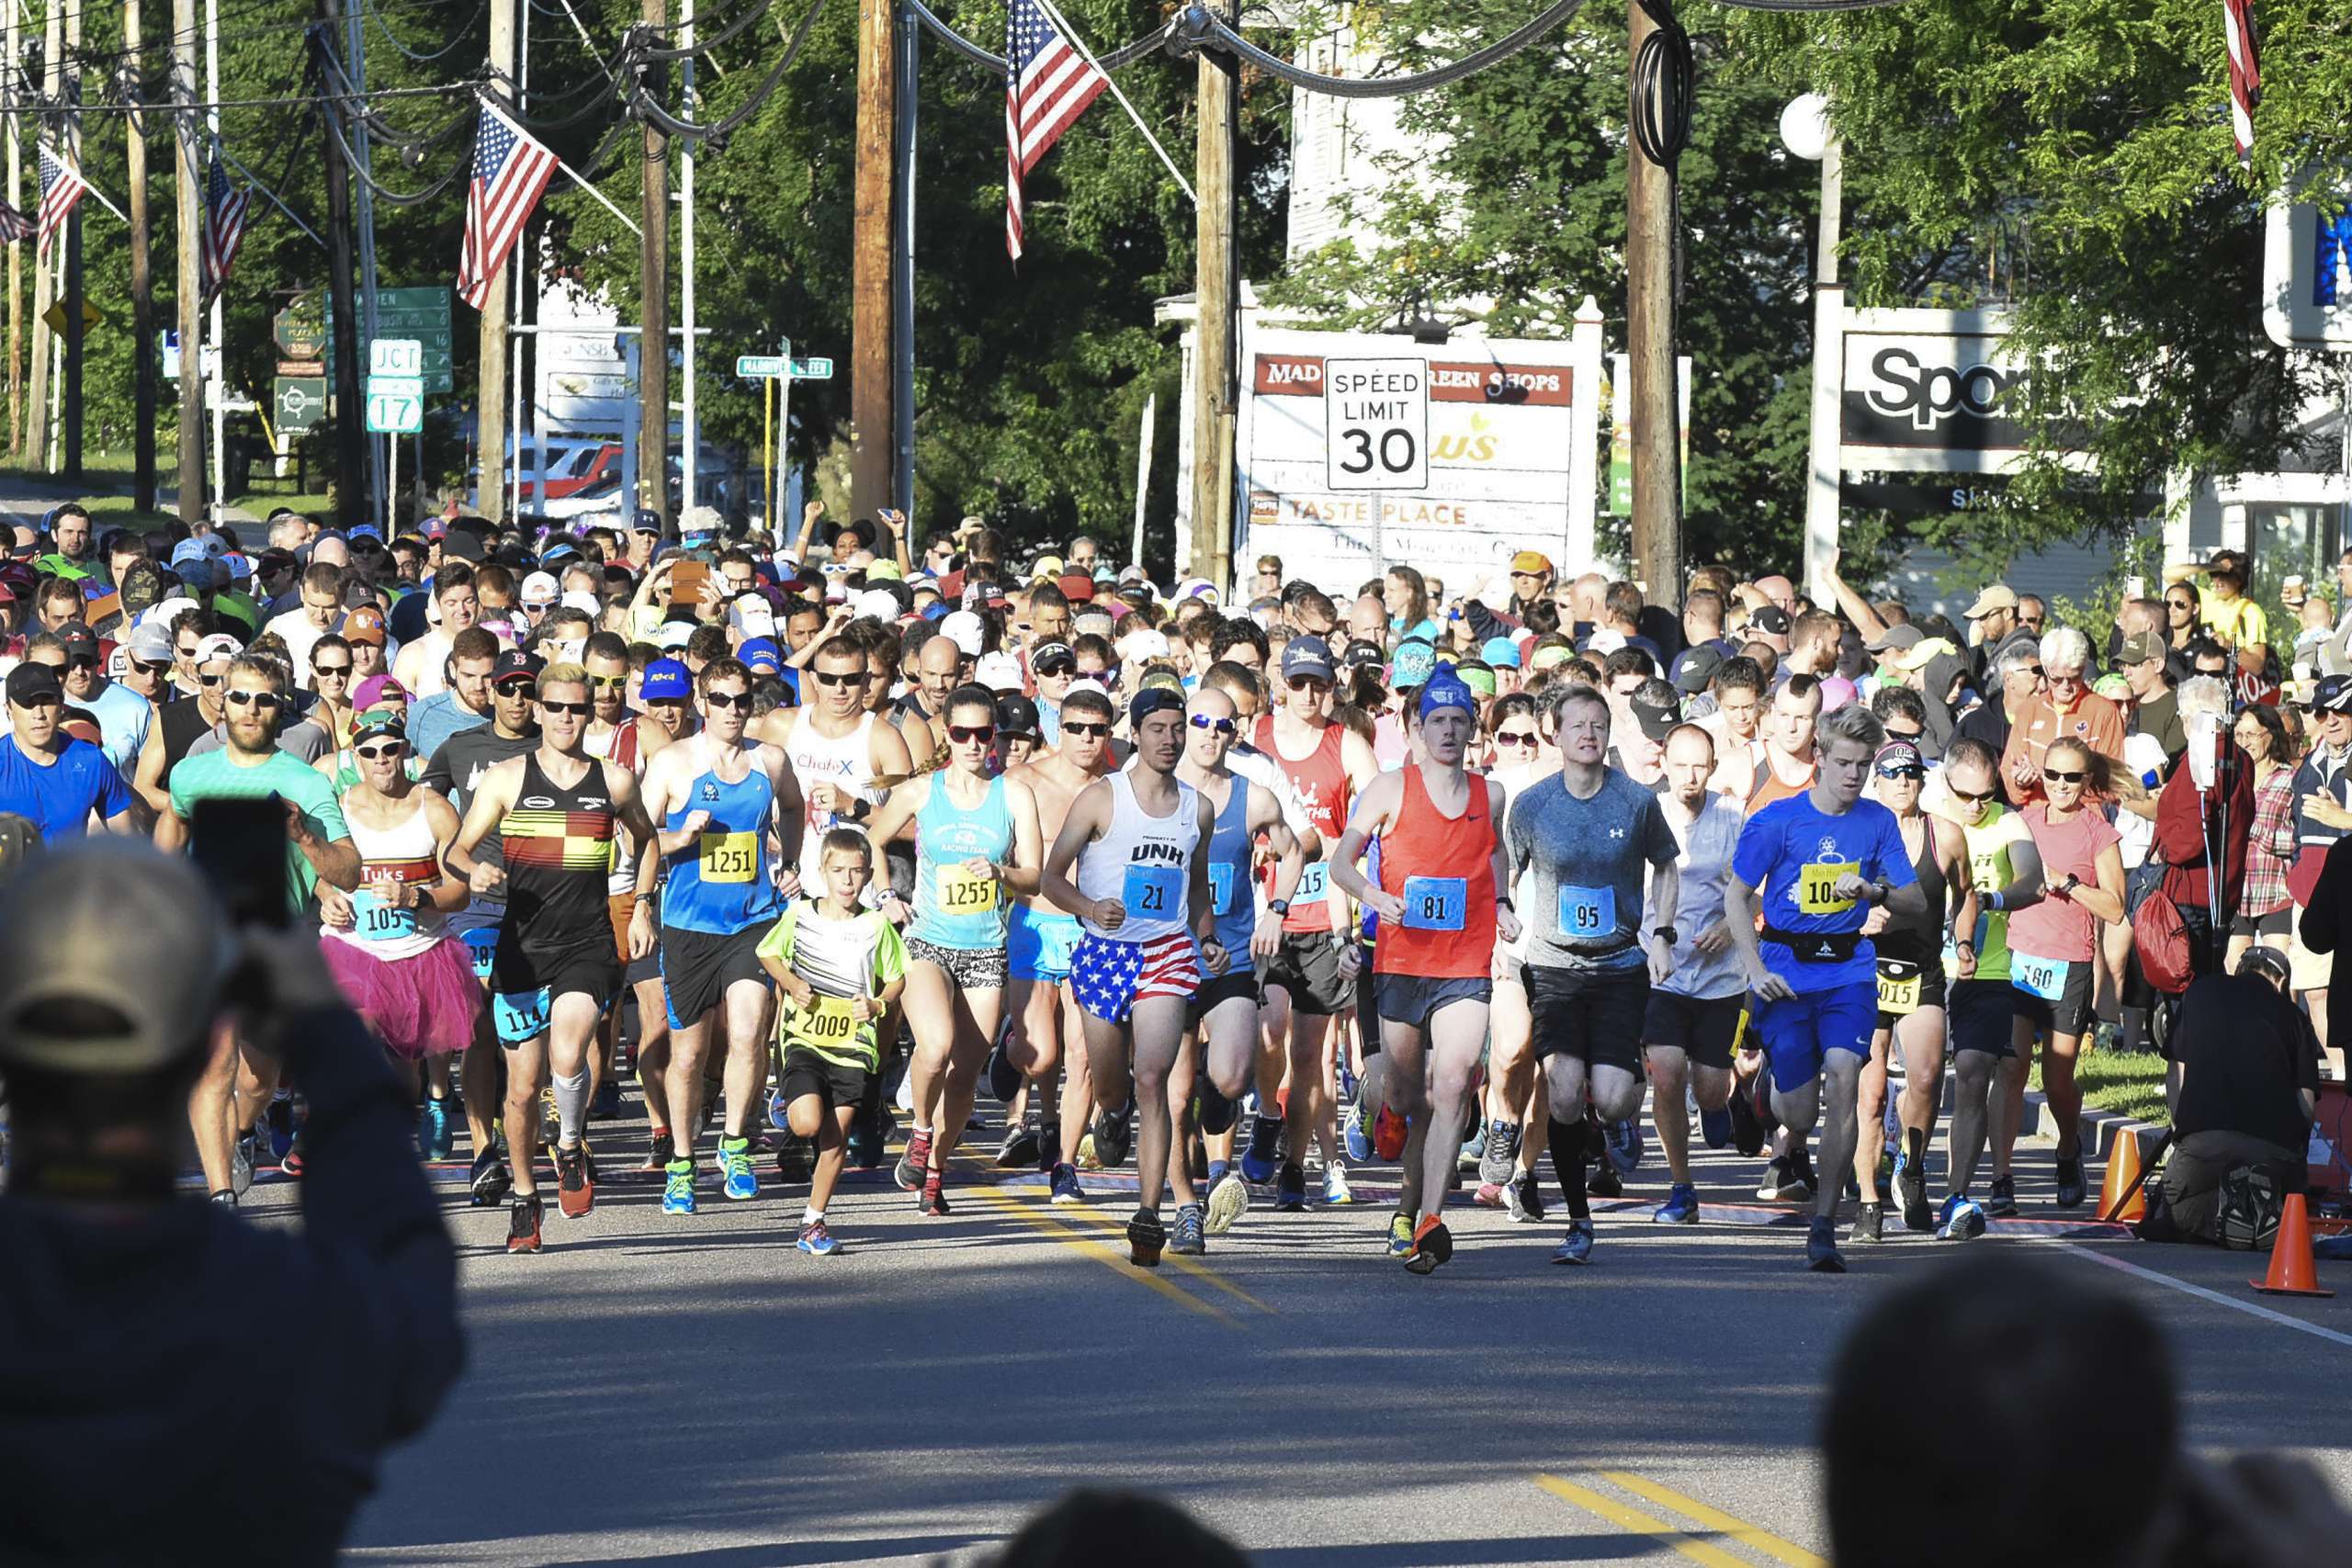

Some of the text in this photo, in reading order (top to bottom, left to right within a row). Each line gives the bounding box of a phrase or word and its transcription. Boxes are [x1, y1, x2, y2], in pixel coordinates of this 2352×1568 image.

[440, 291, 447, 303] 5
[435, 334, 447, 347] 16
[378, 348, 415, 368] JCT
[1266, 363, 1560, 397] MAD REEN SHOPS
[1335, 374, 1419, 394] SPEED
[379, 398, 412, 426] 17
[1344, 401, 1408, 421] LIMIT
[1340, 428, 1415, 474] 30
[1290, 499, 1368, 522] TASTE
[1382, 504, 1467, 525] PLACE
[707, 850, 752, 874] 1251
[1131, 843, 1184, 867] UNH
[361, 865, 404, 883] Tuks
[1295, 871, 1322, 896] 15
[944, 881, 989, 907] 1255
[1141, 884, 1163, 910] 21
[1424, 896, 1446, 919] 81
[1577, 905, 1600, 928] 95
[367, 908, 401, 931] 105
[1879, 982, 1912, 1005] 015
[801, 1011, 851, 1037] 2009
